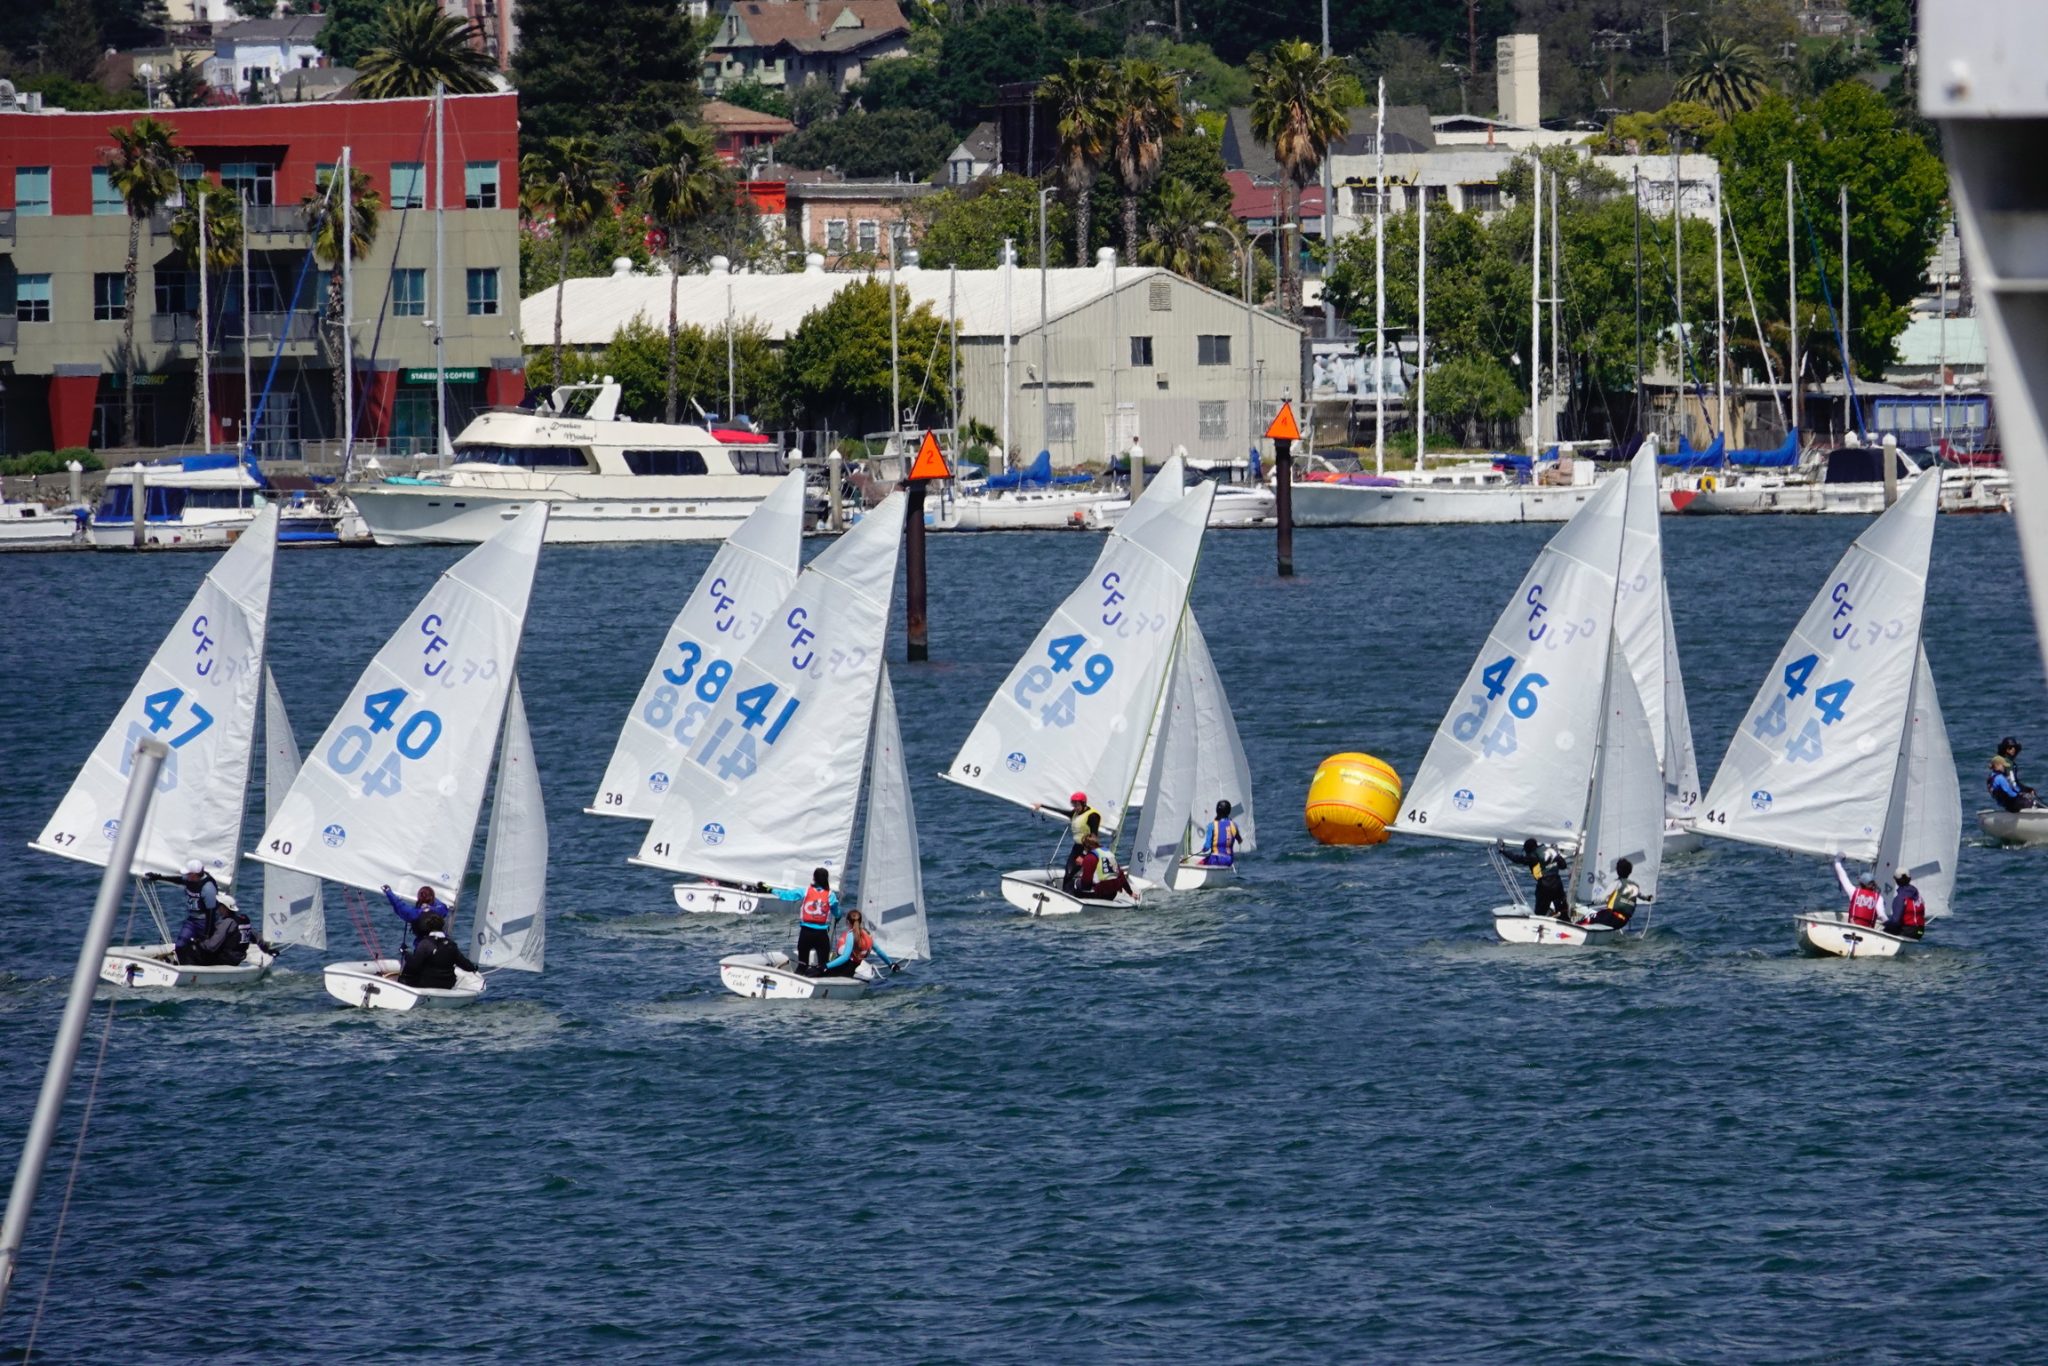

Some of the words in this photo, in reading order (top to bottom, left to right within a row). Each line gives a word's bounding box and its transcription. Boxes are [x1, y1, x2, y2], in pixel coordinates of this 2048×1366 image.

[411, 372, 449, 380] STARBUS
[449, 371, 476, 380] COFFEE
[926, 450, 935, 464] 2
[710, 577, 735, 632] CFJ
[1102, 571, 1125, 626] CFJ
[1526, 585, 1548, 641] CFJ
[1832, 582, 1854, 640] CFJ
[192, 615, 214, 676] CFJ
[421, 614, 449, 677] CFJ
[787, 607, 816, 670] CFJ
[1047, 633, 1113, 695] 49
[663, 641, 733, 703] 38
[1482, 655, 1549, 719] 46
[1784, 654, 1855, 726] 44
[144, 687, 214, 749] 47
[364, 688, 442, 760] 40
[736, 682, 800, 745] 41
[962, 763, 981, 778] 49
[605, 792, 623, 806] 38
[1407, 809, 1427, 824] 46
[1681, 791, 1698, 806] 39
[1706, 809, 1726, 825] 44
[54, 832, 76, 846] 47
[270, 839, 292, 855] 40
[653, 842, 671, 857] 41
[738, 899, 752, 912] 10
